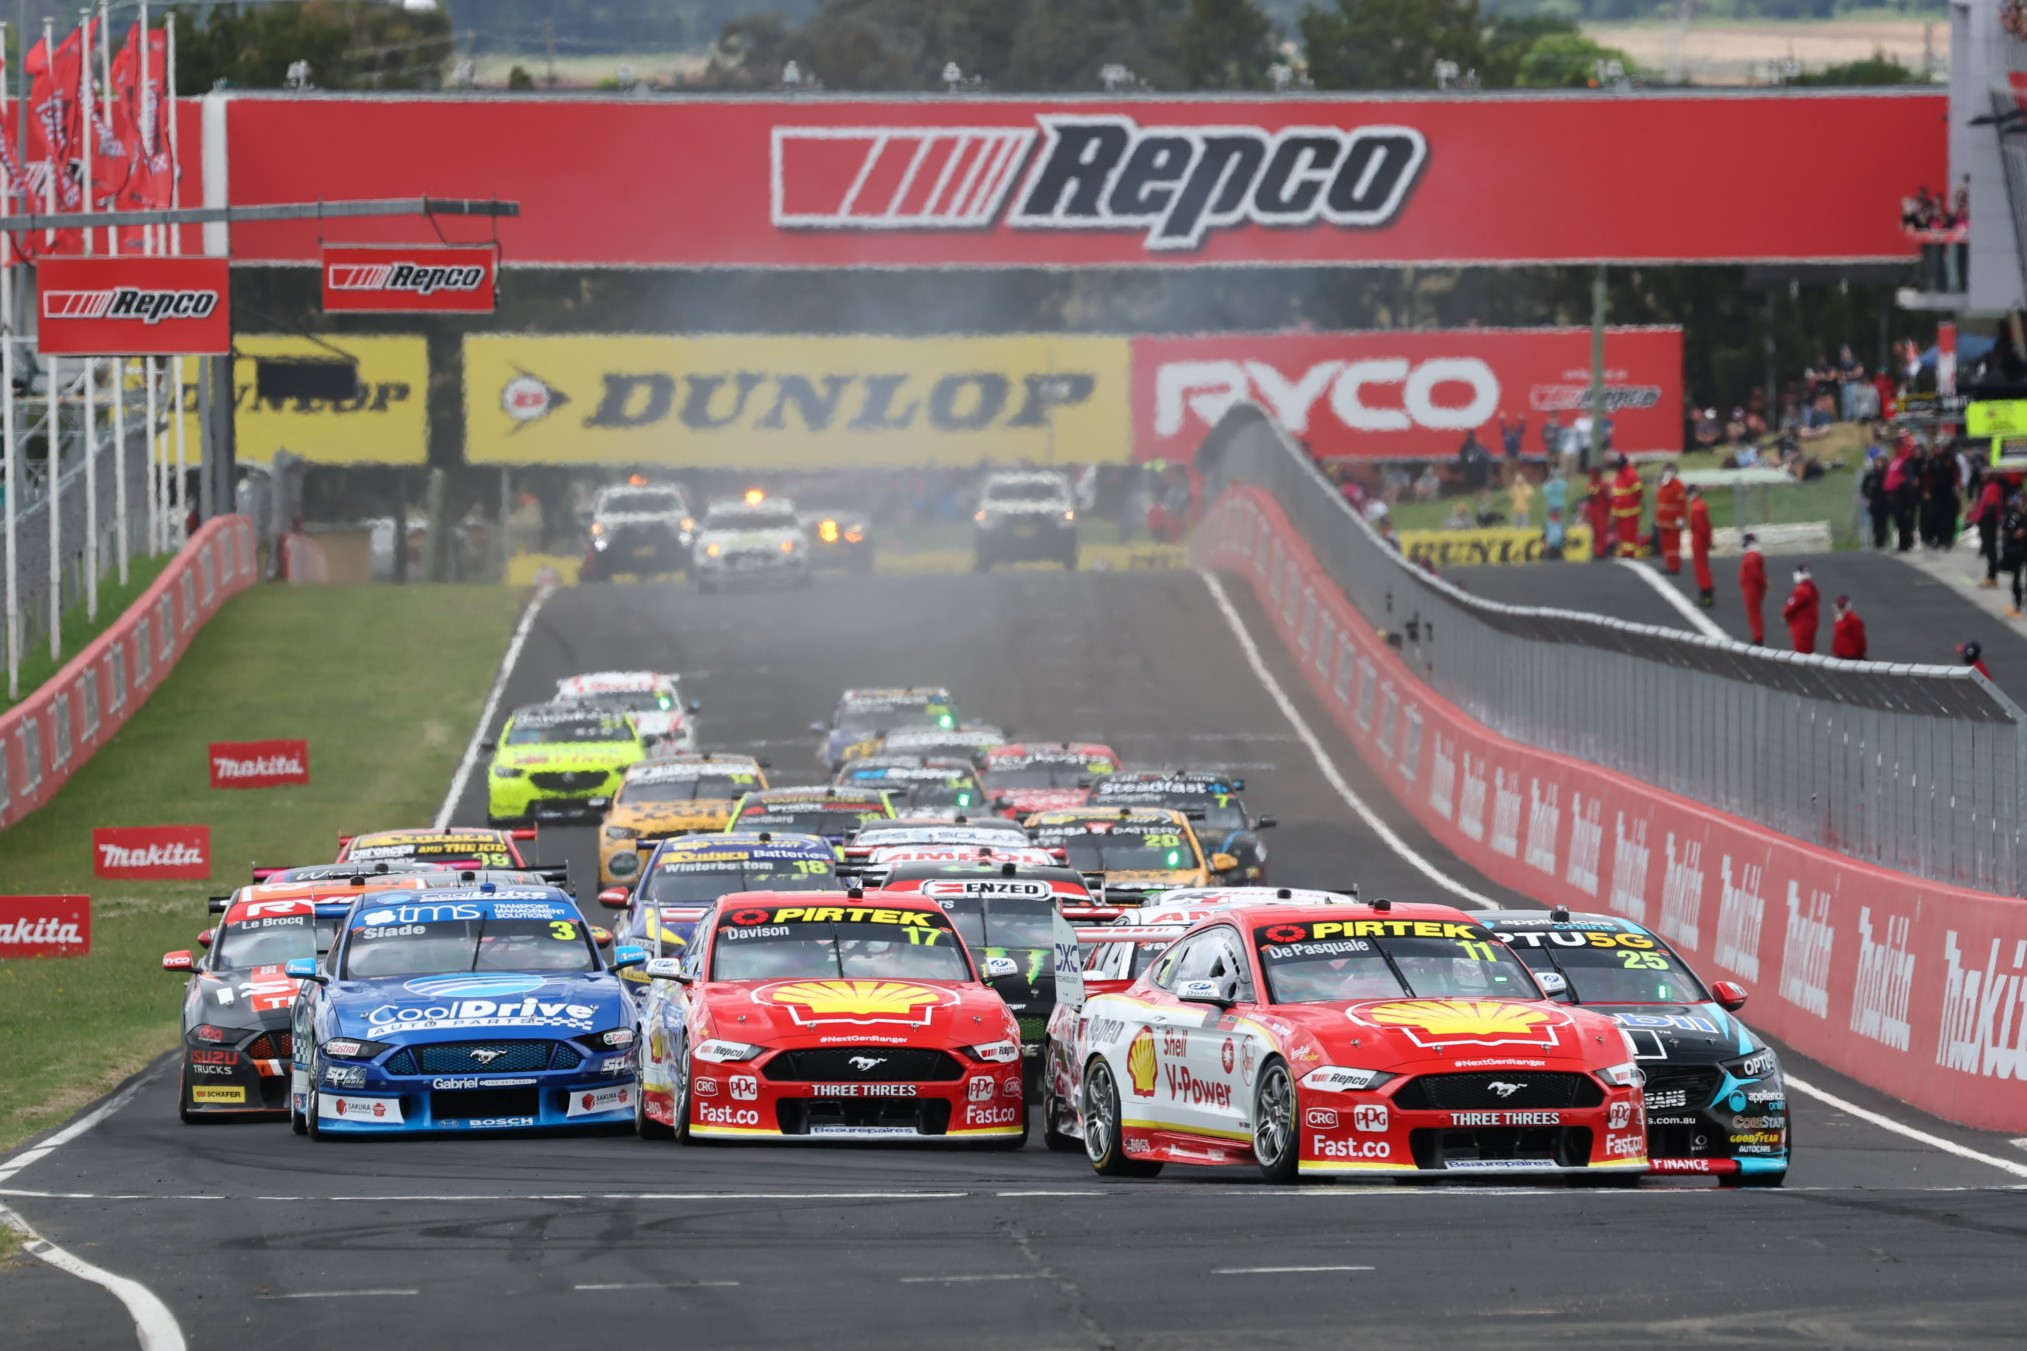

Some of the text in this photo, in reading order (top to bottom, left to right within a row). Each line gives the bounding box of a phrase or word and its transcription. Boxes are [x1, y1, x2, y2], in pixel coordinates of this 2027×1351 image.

[1006, 113, 1426, 249] Repco
[384, 260, 486, 296] Repco
[105, 286, 218, 325] Repco
[581, 370, 1095, 430] DUNLOP
[1155, 356, 1499, 438] RYCO
[1144, 834, 1179, 847] 20
[444, 844, 476, 853] THE
[754, 850, 831, 860] Batteries
[792, 860, 829, 875] 18
[965, 883, 1038, 895] ENZED
[397, 904, 480, 922] tms
[773, 908, 934, 926] PIRTEK
[0, 917, 83, 944] akita
[242, 916, 303, 930] Le Brocq
[549, 921, 576, 940] 3
[1313, 921, 1478, 940] PIRTEK
[363, 924, 426, 939] Slade
[728, 925, 790, 940] Davison
[902, 927, 942, 946] 17
[1495, 931, 1654, 949] PTU5G
[1456, 940, 1497, 962] 11
[1617, 951, 1670, 970] 25
[820, 1035, 908, 1044] #NextGenRanger
[1164, 1028, 1189, 1057] Shell
[332, 1043, 357, 1054] Castrol
[713, 1045, 744, 1058] Repco
[193, 1065, 233, 1075] TRUCKS
[1455, 1058, 1546, 1067] #NextGenRanger
[433, 1077, 478, 1089] Gabriel
[696, 1081, 715, 1093] CRC
[1164, 1063, 1232, 1109] V-Power
[1330, 1073, 1369, 1086] Repco
[596, 1093, 617, 1101] SAKURA
[812, 1085, 917, 1096] THREE THREES
[349, 1103, 371, 1111] SAKURA
[699, 1102, 759, 1125] Fast.co
[966, 1105, 1015, 1124] Fast.co
[470, 1117, 533, 1126] BOSCH
[1308, 1112, 1336, 1124] CRC
[1450, 1112, 1560, 1125] THREE THREES
[1313, 1135, 1391, 1158] Fast.co
[1449, 1160, 1553, 1168] Beaurepaires
[1653, 1159, 1709, 1171] FINANCE
